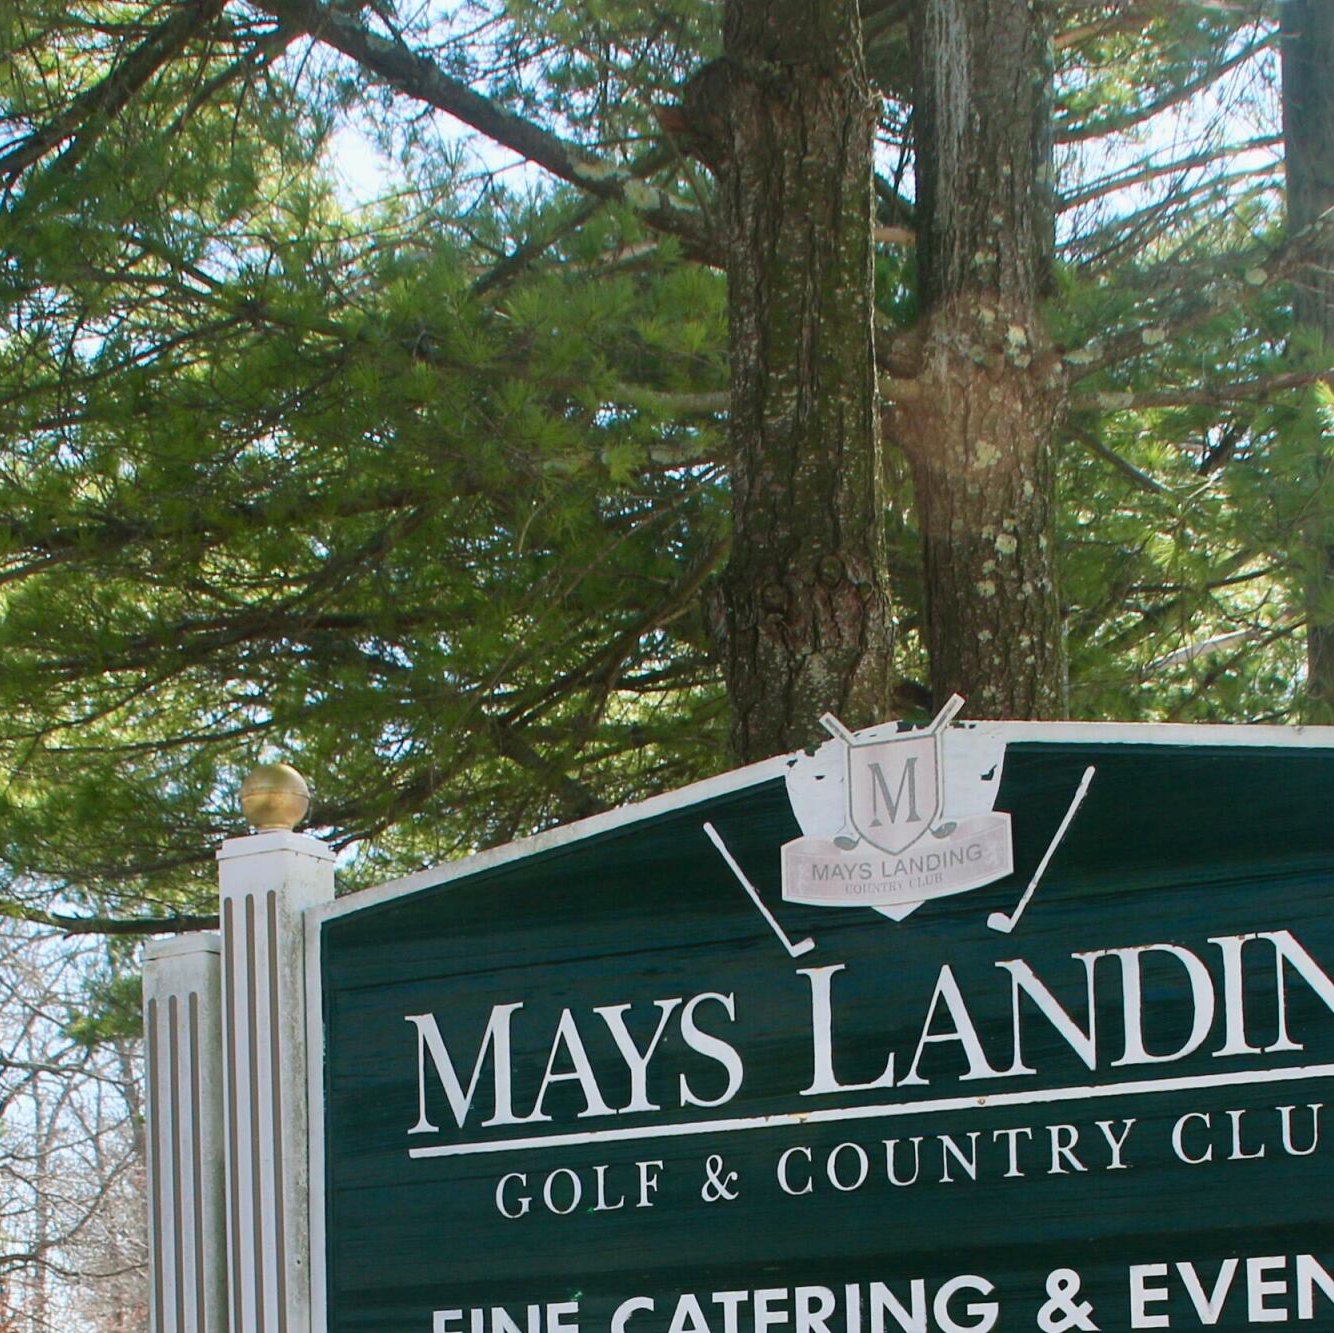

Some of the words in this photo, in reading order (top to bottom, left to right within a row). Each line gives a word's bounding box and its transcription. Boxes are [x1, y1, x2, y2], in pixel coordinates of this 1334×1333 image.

[867, 757, 920, 827] M
[812, 862, 873, 881] MAYS
[881, 843, 983, 878] LANDING
[845, 880, 904, 895] COUNTRY
[908, 872, 944, 888] CLUB
[405, 991, 745, 1136] MAYS
[494, 1159, 666, 1220] GOLF
[700, 1153, 740, 1203] &
[776, 1117, 1138, 1196] COUNTRY
